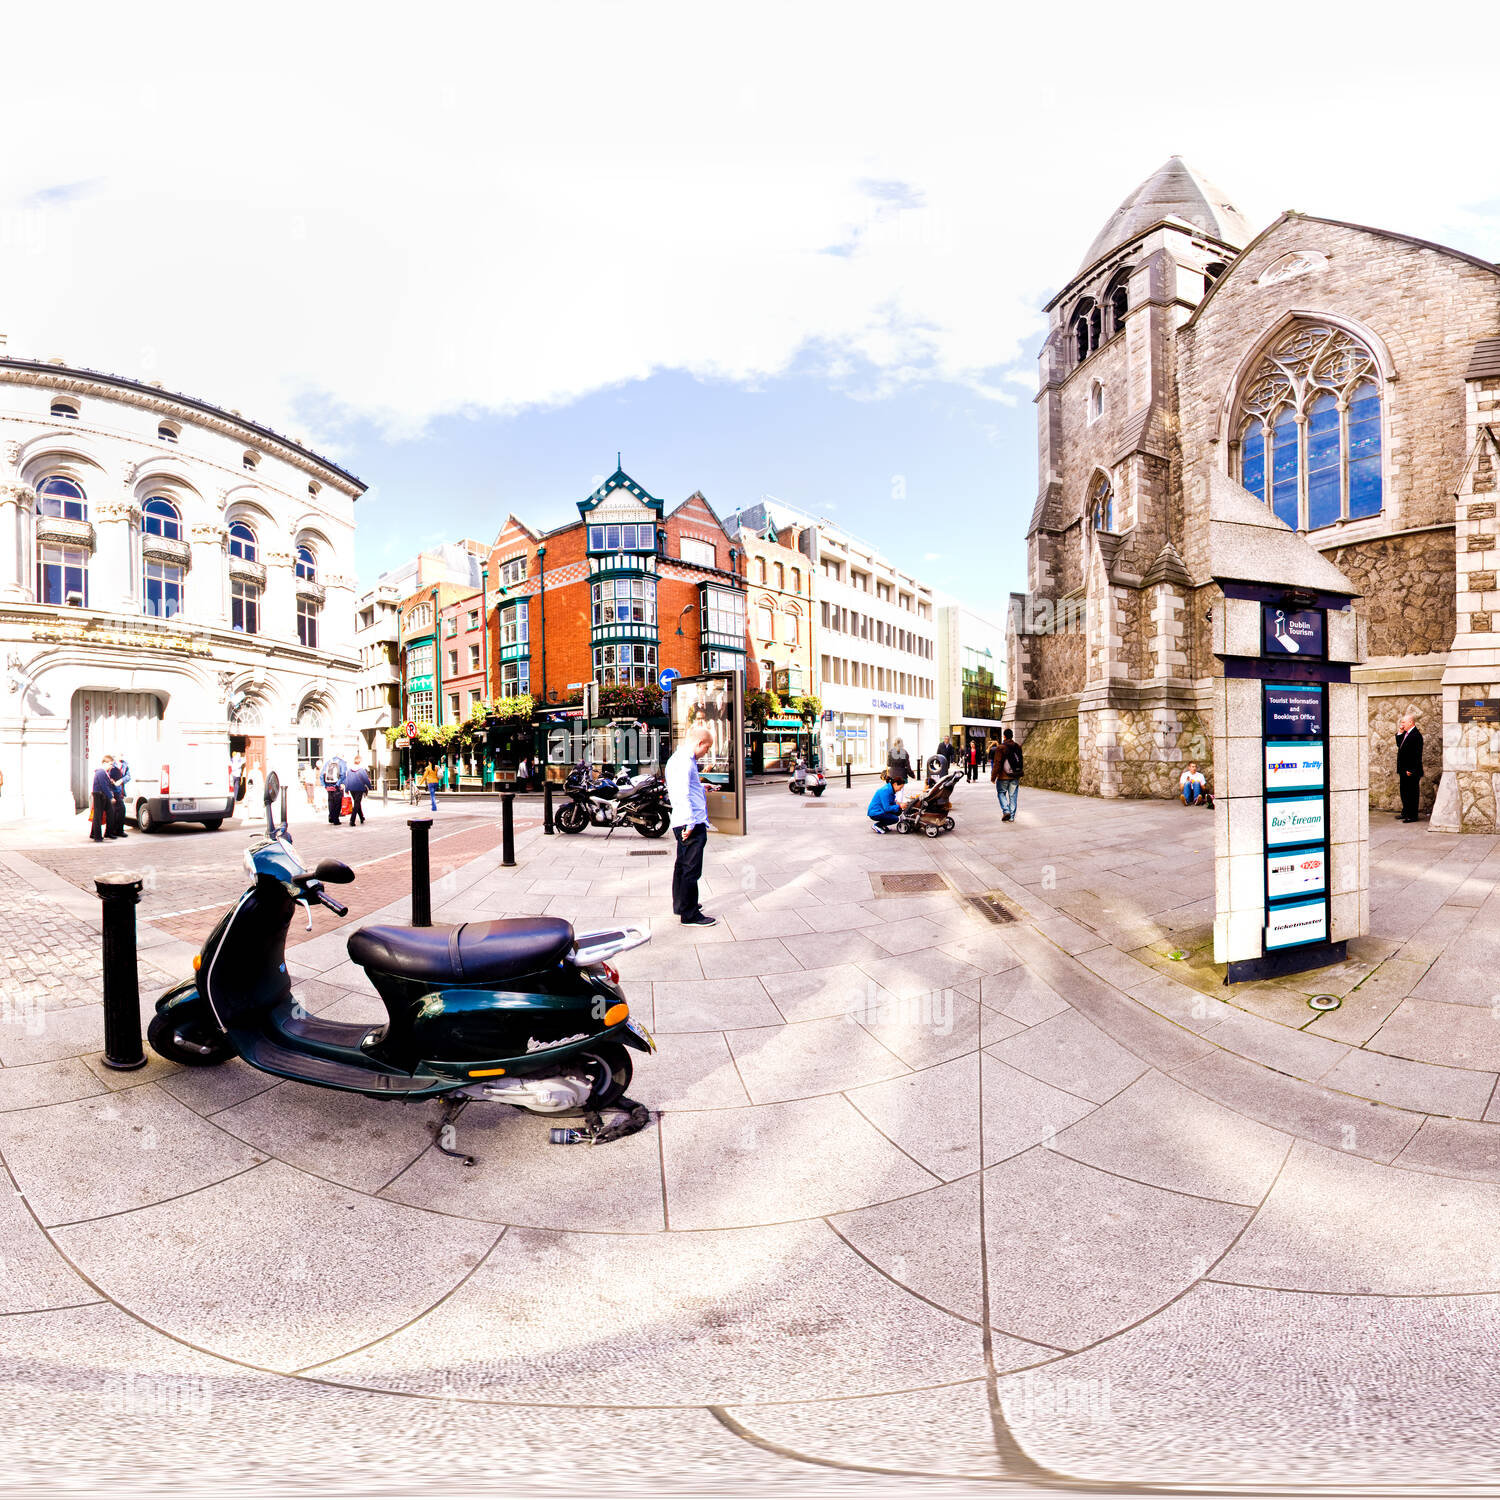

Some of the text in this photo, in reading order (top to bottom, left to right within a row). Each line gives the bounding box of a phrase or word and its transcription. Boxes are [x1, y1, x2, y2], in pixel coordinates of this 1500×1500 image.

[1289, 621, 1311, 629] Dublin
[1289, 628, 1314, 636] Tourism
[1273, 713, 1299, 721] Bookings
[1302, 761, 1323, 769] Thrifty
[1271, 816, 1286, 827] Bus
[1274, 918, 1323, 931] ticketmaster
